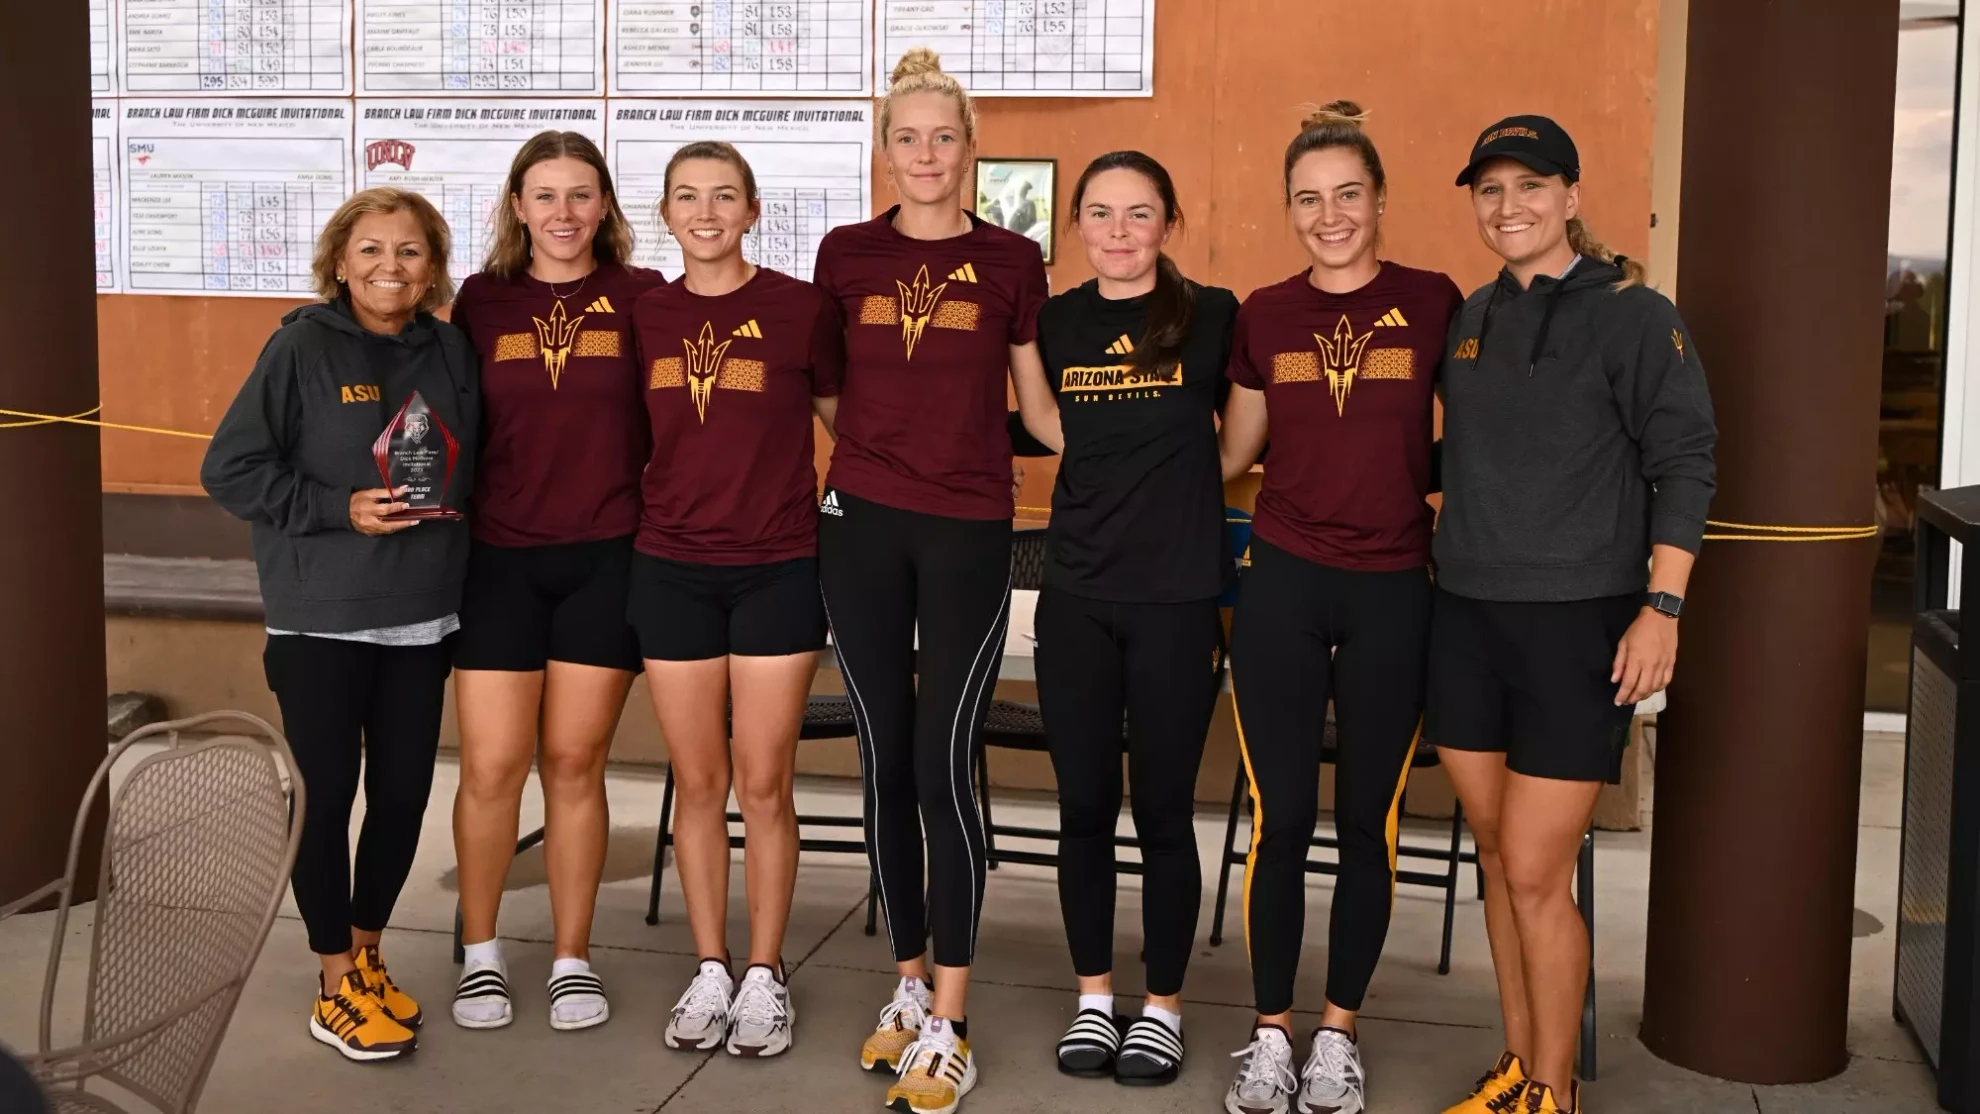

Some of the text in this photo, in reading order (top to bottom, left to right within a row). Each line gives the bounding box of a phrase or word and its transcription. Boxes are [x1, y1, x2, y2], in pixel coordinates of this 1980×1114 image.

[484, 7, 498, 19] 76
[745, 5, 758, 18] 81
[770, 6, 792, 18] 153
[484, 24, 496, 36] 75
[505, 24, 526, 36] 155
[744, 22, 757, 36] 81
[771, 23, 792, 36] 158
[1019, 20, 1033, 32] 76
[1044, 20, 1066, 32] 155
[505, 58, 524, 70] 151
[770, 58, 792, 70] 158
[204, 76, 224, 88] 295
[504, 76, 527, 87] 590
[127, 108, 345, 119] BRANCH LAW FIRM DICK MCGUIRE INVITATIONAL
[364, 108, 597, 120] BRANCH LAW FIRM DICK MCGUIRE INVITATIONAL
[616, 110, 864, 122] BRANCH LAW FIRM DICK MCGUIRE INVITATIONAL
[129, 144, 155, 154] SMU
[366, 139, 416, 171] UNLV
[767, 204, 788, 215] 154
[768, 236, 788, 250] 154
[1453, 338, 1480, 359] ASU
[1064, 370, 1125, 388] ARIZONA
[340, 384, 381, 404] ASU
[820, 504, 844, 516] didas
